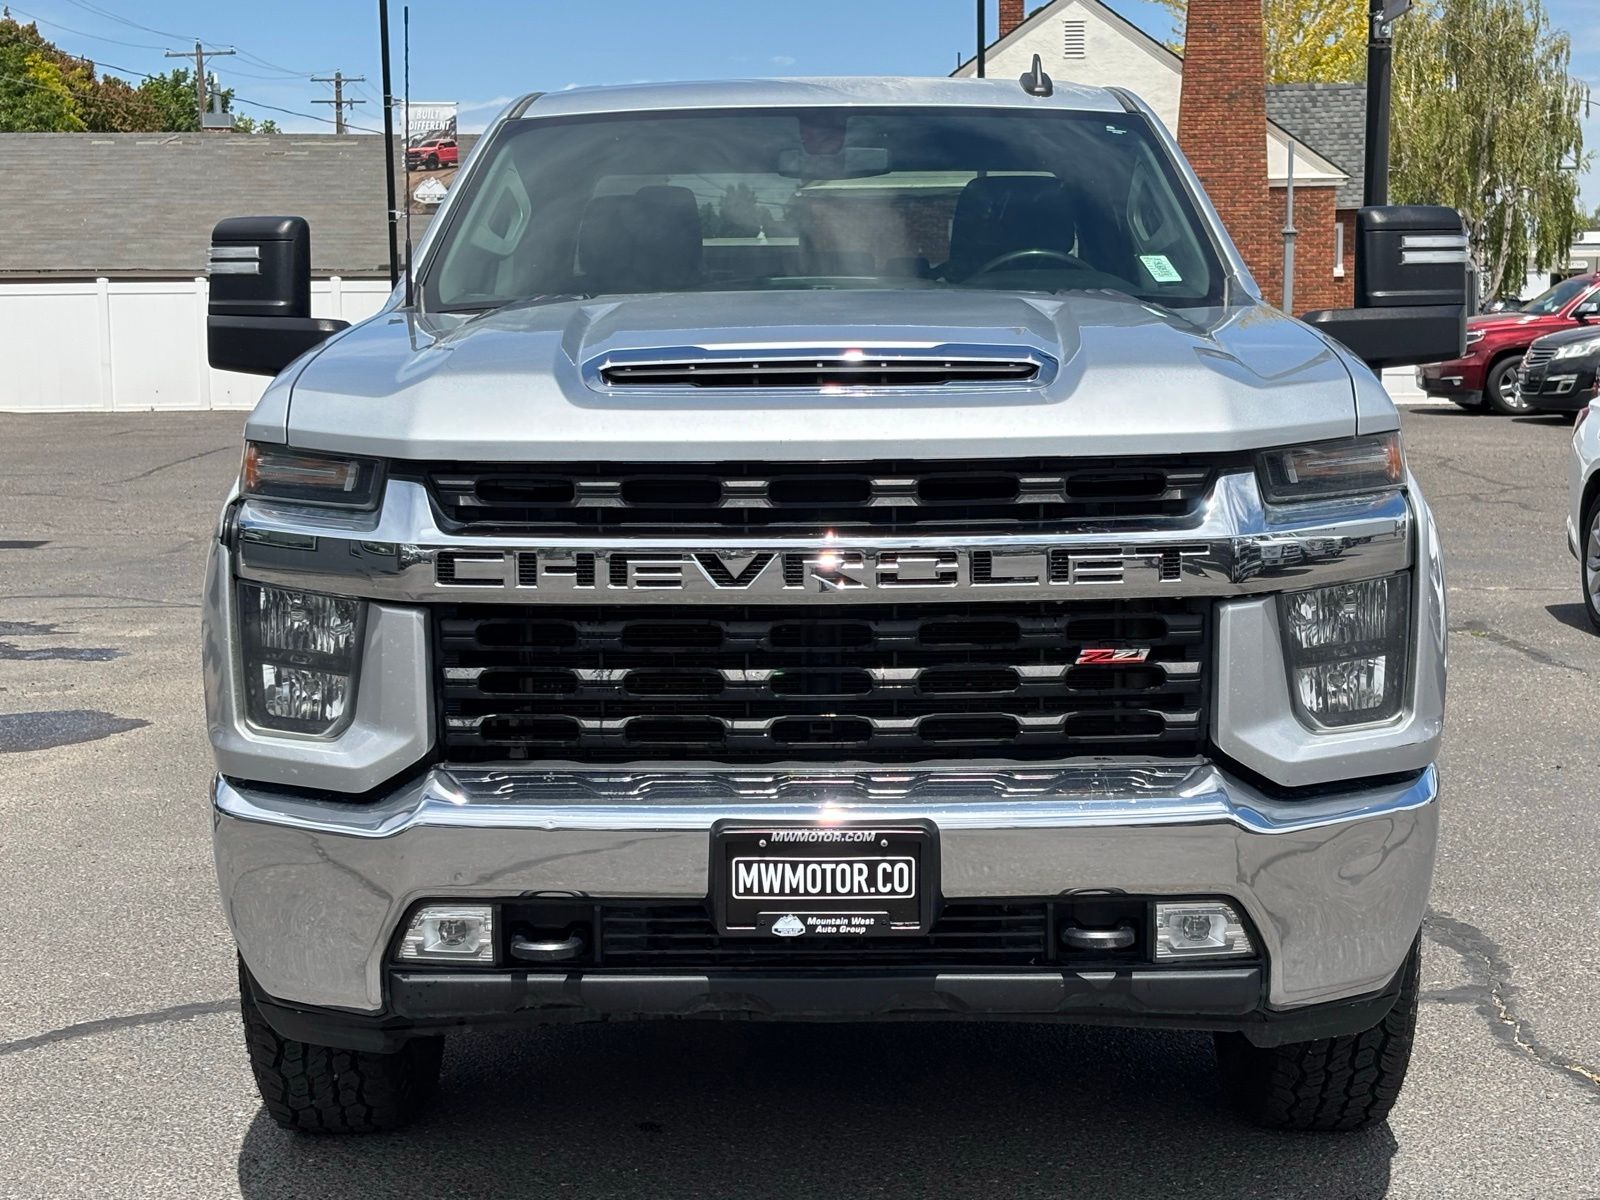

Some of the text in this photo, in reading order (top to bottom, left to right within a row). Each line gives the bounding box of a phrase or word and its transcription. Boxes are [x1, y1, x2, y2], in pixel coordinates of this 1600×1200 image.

[416, 110, 440, 119] BUILT
[409, 120, 451, 130] DIFFERENT
[434, 544, 1210, 589] CHEVROLET
[1075, 649, 1150, 665] Z71
[771, 831, 876, 842] MWMOTOR.COM
[738, 863, 909, 894] MWMOTOR.CO
[807, 917, 875, 925] Mountain West
[839, 926, 866, 934] Group
